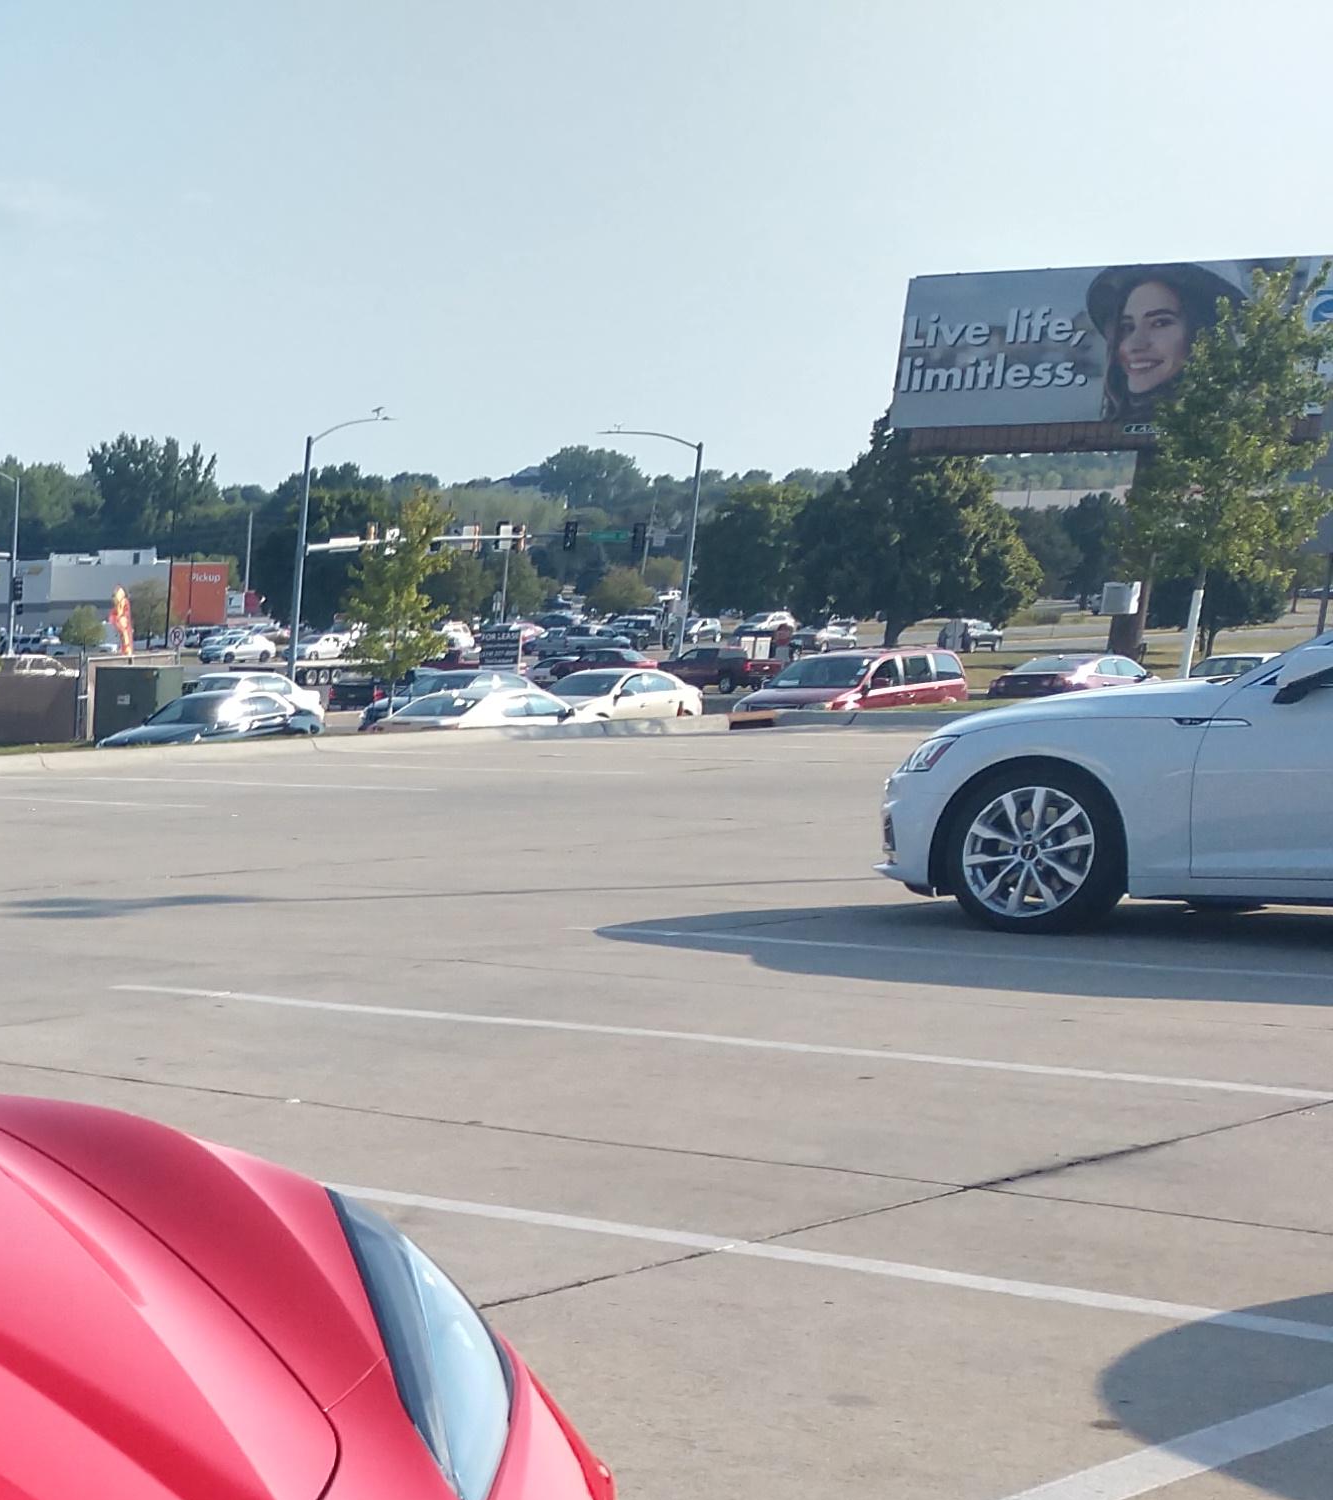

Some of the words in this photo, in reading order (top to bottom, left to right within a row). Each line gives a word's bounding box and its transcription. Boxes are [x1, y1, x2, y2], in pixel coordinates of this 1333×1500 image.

[906, 312, 991, 350] Live
[1005, 305, 1087, 348] life,
[899, 351, 1089, 394] limitless.
[192, 572, 221, 584] Pickup
[480, 632, 497, 641] FOR
[498, 632, 519, 640] LEASE
